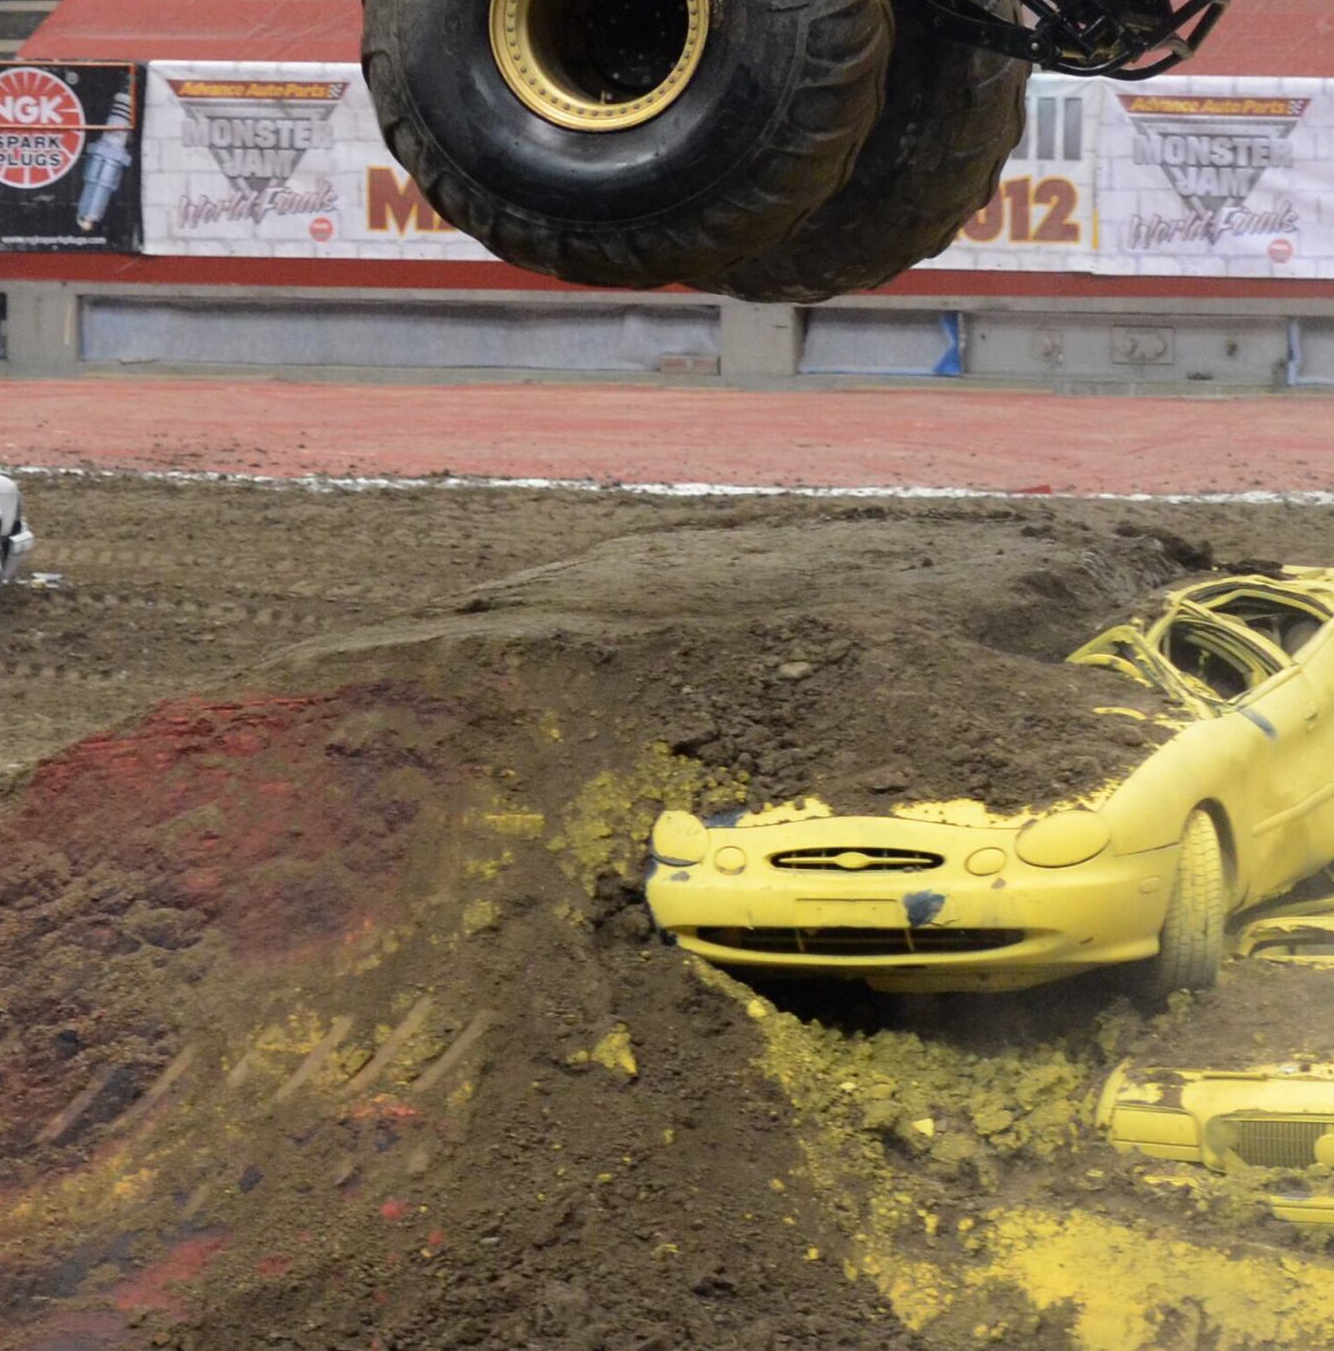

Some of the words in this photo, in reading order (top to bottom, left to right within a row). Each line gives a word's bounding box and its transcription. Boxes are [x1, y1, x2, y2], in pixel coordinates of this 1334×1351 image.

[181, 118, 334, 149] MONSTER
[219, 149, 295, 179] JAM
[1133, 136, 1294, 168] MONSTER
[1173, 167, 1251, 197] JAM
[957, 174, 1082, 243] 012
